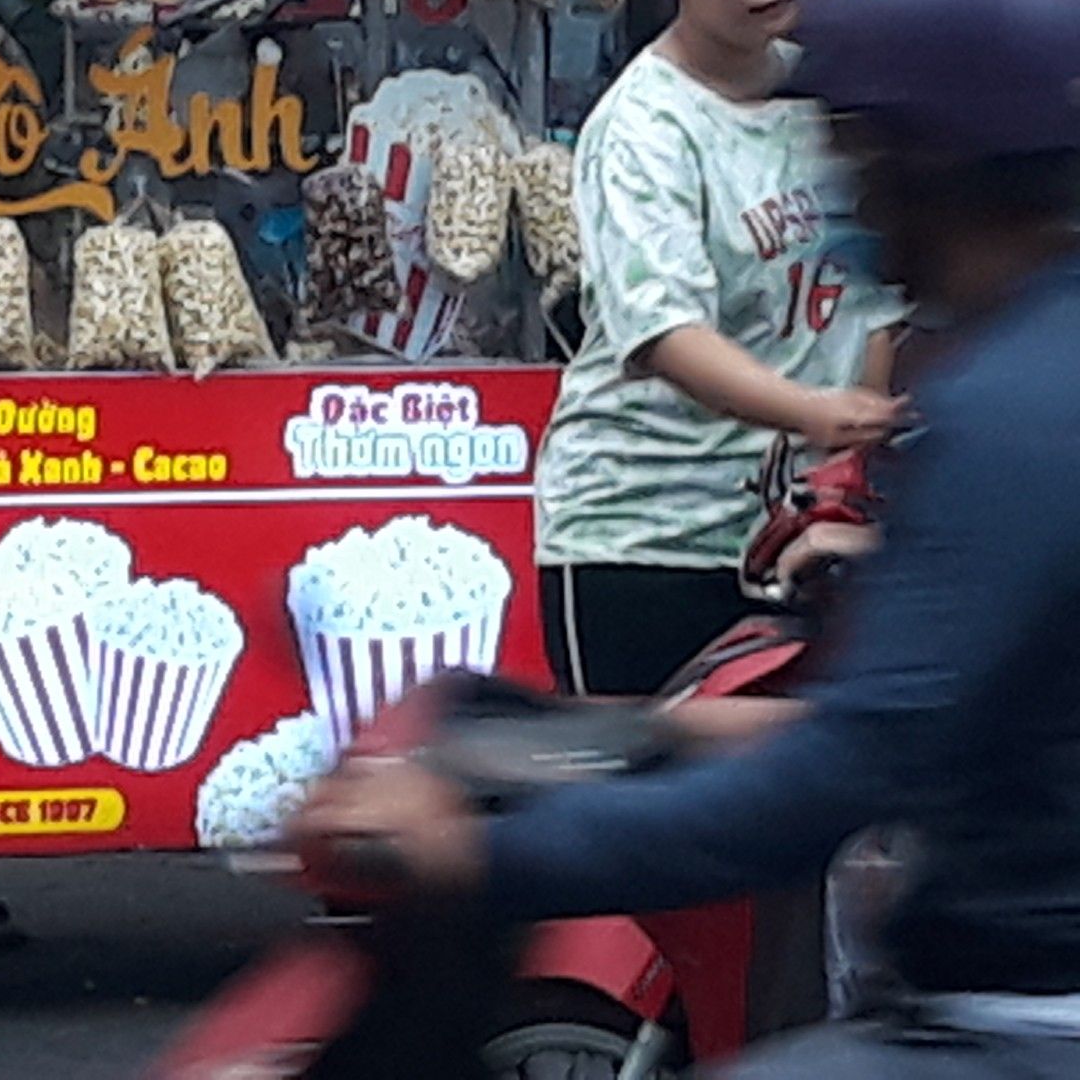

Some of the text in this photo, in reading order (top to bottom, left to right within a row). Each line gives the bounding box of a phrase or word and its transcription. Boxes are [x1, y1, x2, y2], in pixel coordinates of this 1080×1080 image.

[79, 26, 319, 181] Ánh
[18, 449, 102, 485] Xanh
[133, 445, 227, 483] Cacao
[420, 430, 522, 478] ngon
